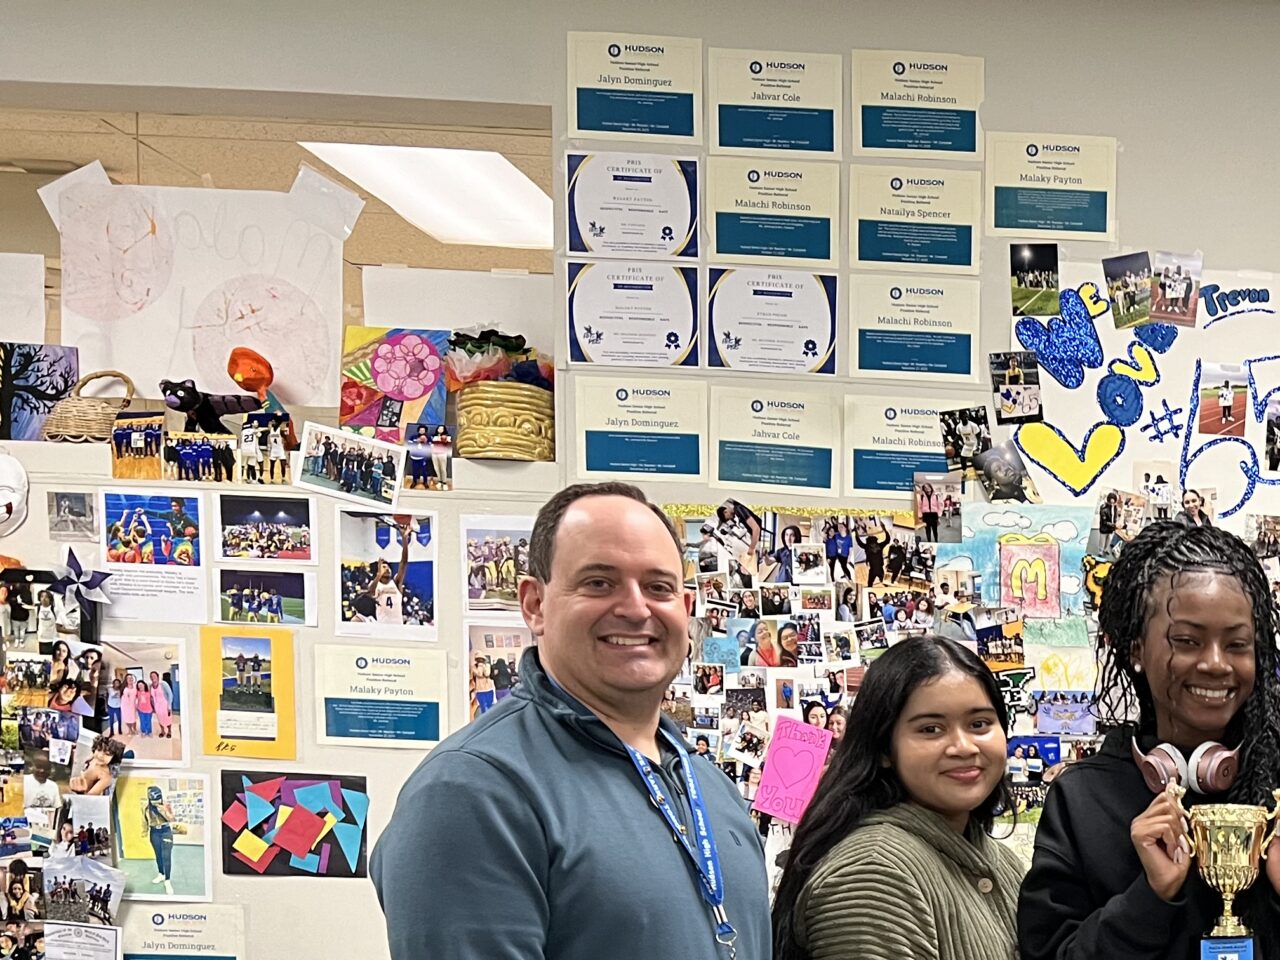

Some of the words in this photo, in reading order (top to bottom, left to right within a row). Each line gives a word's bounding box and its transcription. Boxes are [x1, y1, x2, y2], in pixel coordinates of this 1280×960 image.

[625, 45, 664, 54] HUDSON
[767, 62, 805, 70] HUDSON
[910, 63, 947, 71] HUDSON
[598, 75, 621, 84] Jalyn
[624, 76, 672, 87] Dominguez
[881, 92, 915, 101] Malachi
[918, 95, 956, 103] Robinson
[1020, 174, 1051, 184] Malaky
[1054, 175, 1082, 184] Payton
[735, 200, 769, 208] Malachi
[772, 202, 811, 210] Robinson
[918, 210, 951, 218] Spencer
[1200, 284, 1269, 317] Trevon
[878, 316, 911, 325] Malachi
[914, 318, 952, 327] Robinson
[768, 401, 804, 409] HUDSON
[605, 418, 629, 427] Jalyn
[632, 419, 679, 428] Dominguez
[782, 432, 800, 440] Cole
[872, 436, 905, 446] Malachi
[386, 597, 393, 608] 4
[350, 685, 381, 694] Malaky
[384, 687, 413, 695] Payton
[778, 720, 826, 749] Thank
[696, 809, 707, 836] School
[702, 839, 712, 857] High
[168, 942, 216, 951] Dominguez
